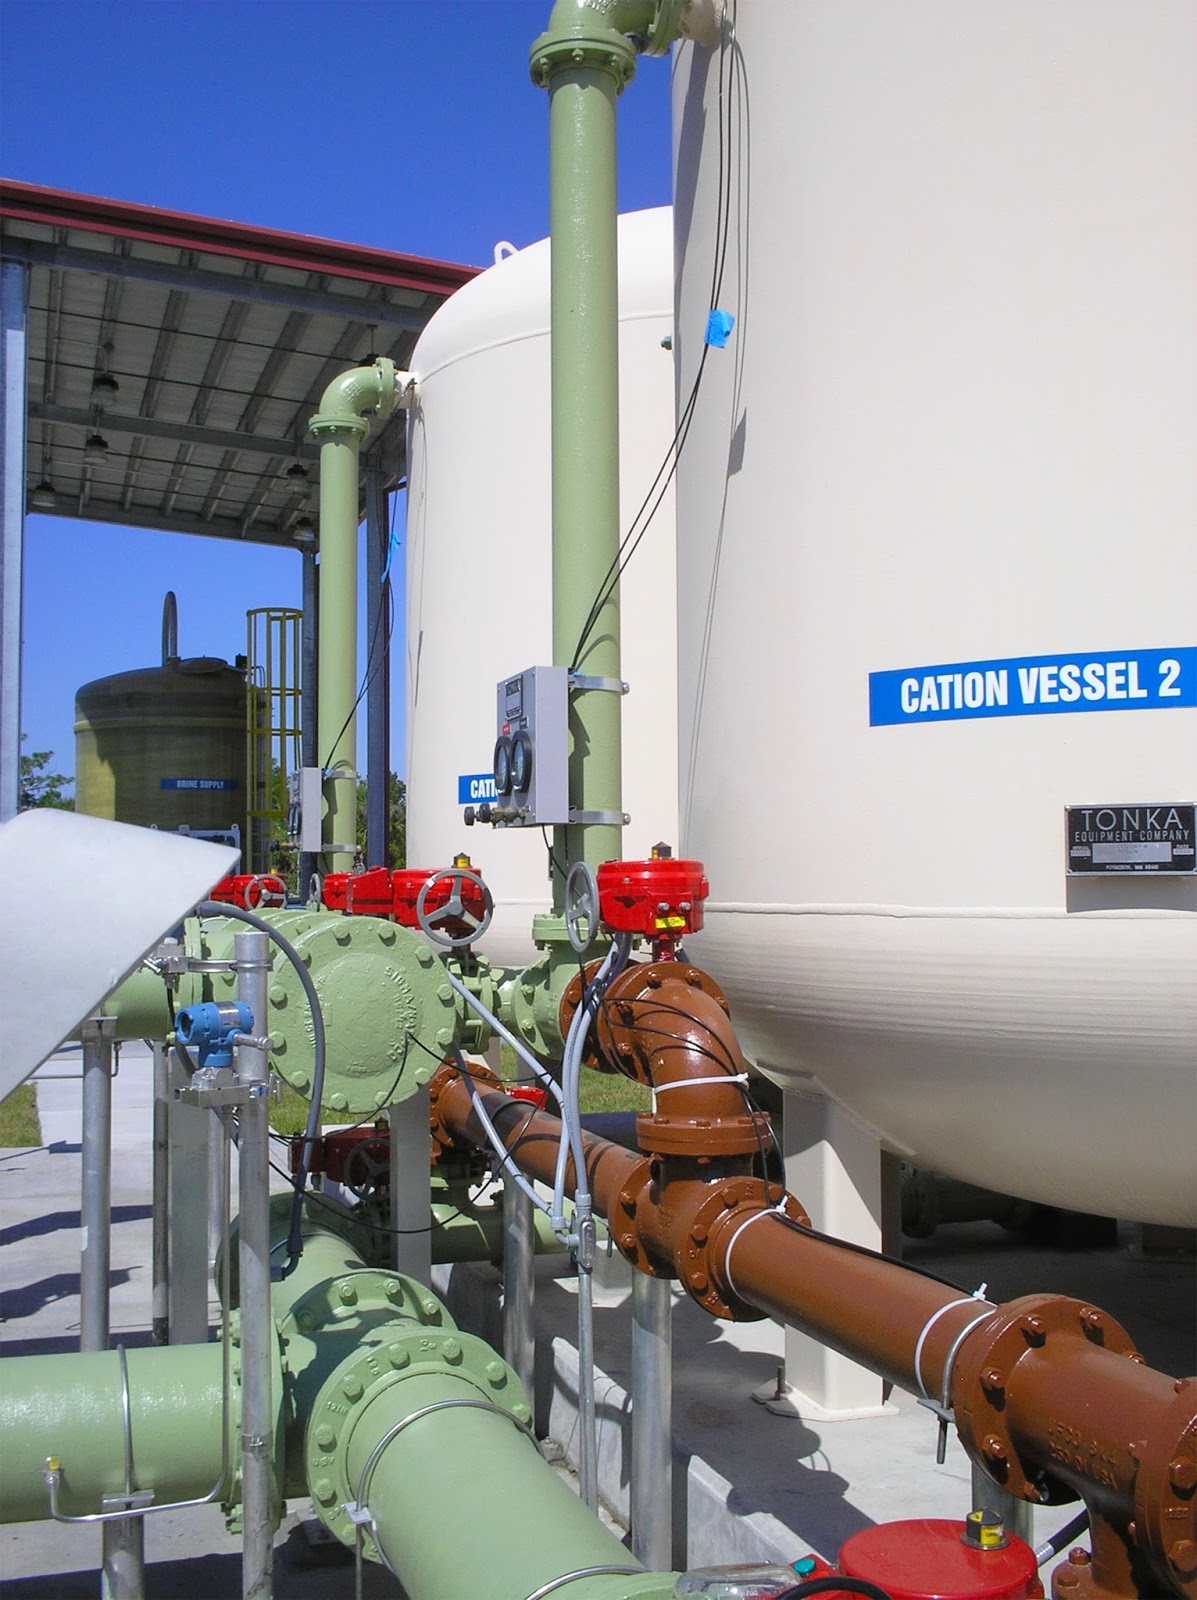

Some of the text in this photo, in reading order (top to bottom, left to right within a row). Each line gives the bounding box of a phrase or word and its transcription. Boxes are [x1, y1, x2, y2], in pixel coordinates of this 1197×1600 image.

[900, 658, 1182, 714] CATION VESSEL 2
[177, 780, 224, 789] BRINE SUPPLY
[1081, 808, 1183, 831] TONKA
[1074, 829, 1190, 842] EQUIPMENT COMPANY
